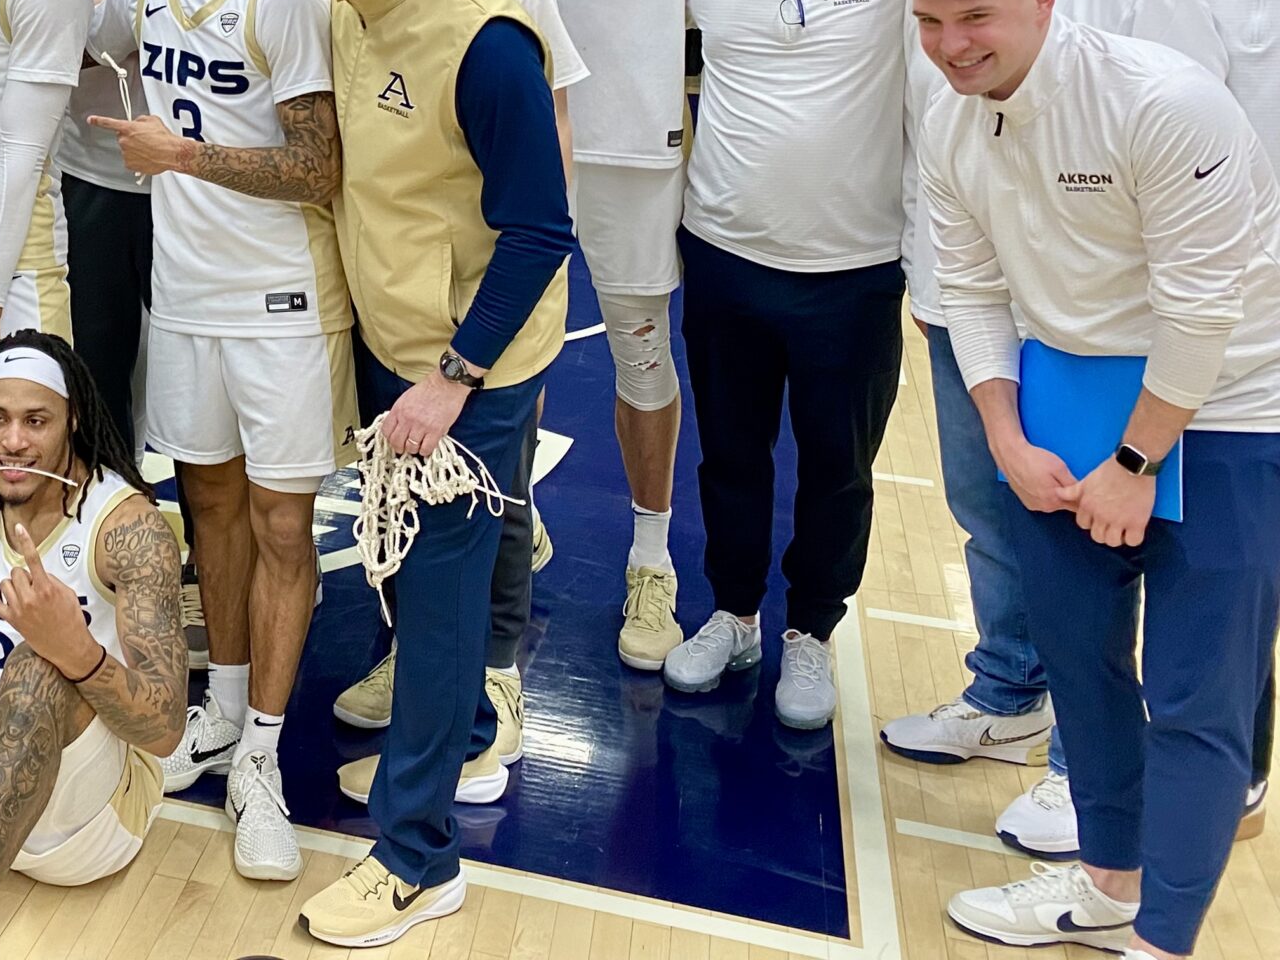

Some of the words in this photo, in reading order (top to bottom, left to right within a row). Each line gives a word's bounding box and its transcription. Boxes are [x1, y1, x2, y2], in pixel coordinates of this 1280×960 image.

[142, 41, 250, 95] ZIPS
[377, 71, 416, 110] A
[172, 98, 206, 143] 3
[1058, 173, 1113, 184] AKRON
[294, 297, 302, 306] M
